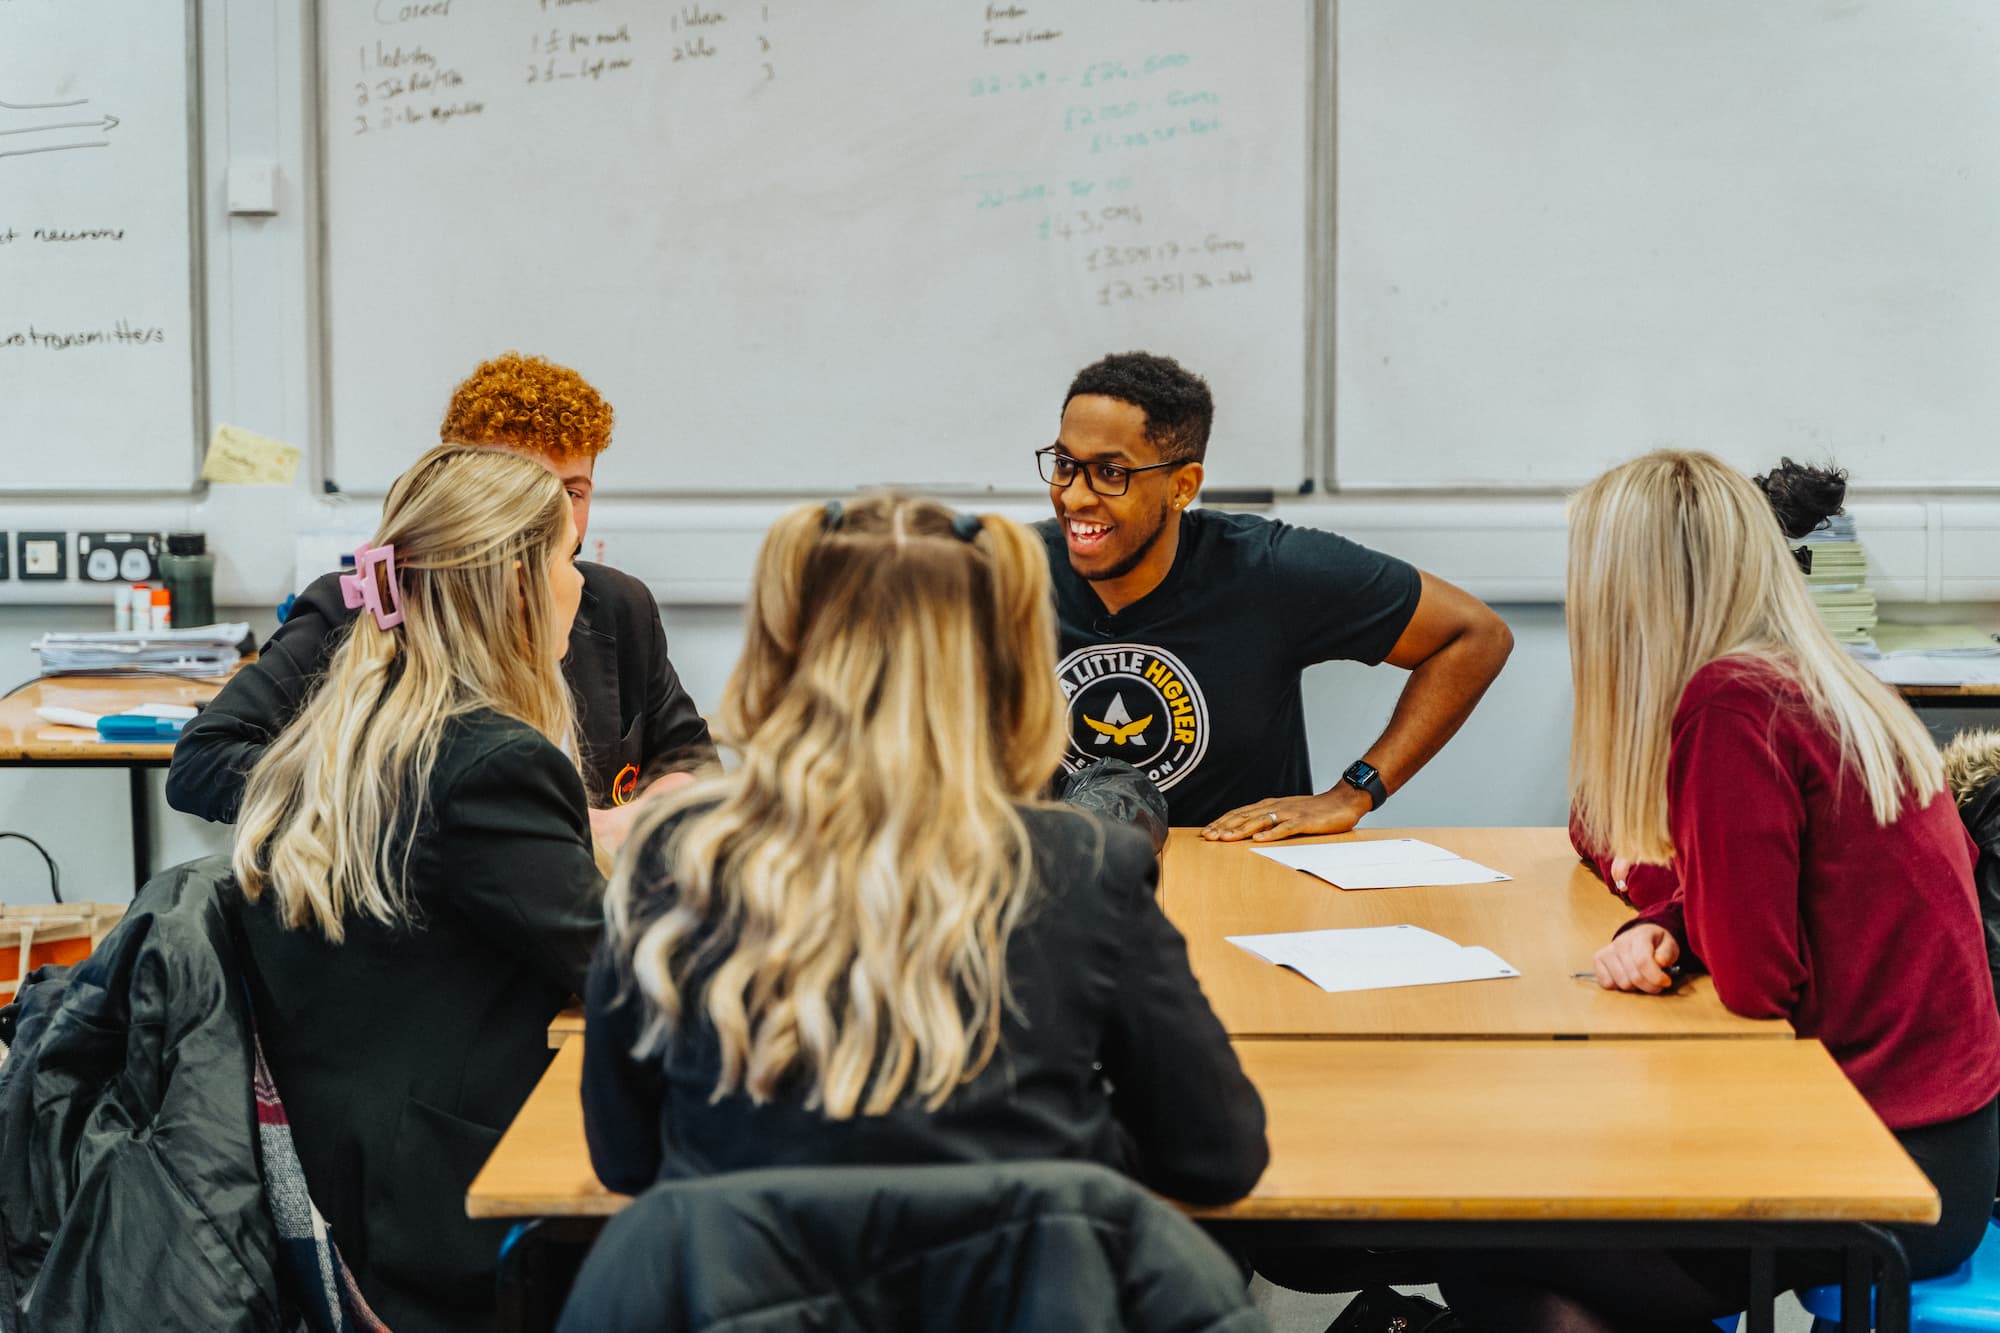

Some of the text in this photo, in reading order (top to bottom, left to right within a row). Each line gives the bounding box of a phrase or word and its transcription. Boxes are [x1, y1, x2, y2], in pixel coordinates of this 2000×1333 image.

[1059, 652, 1196, 744] A LITTLE HIGHER
